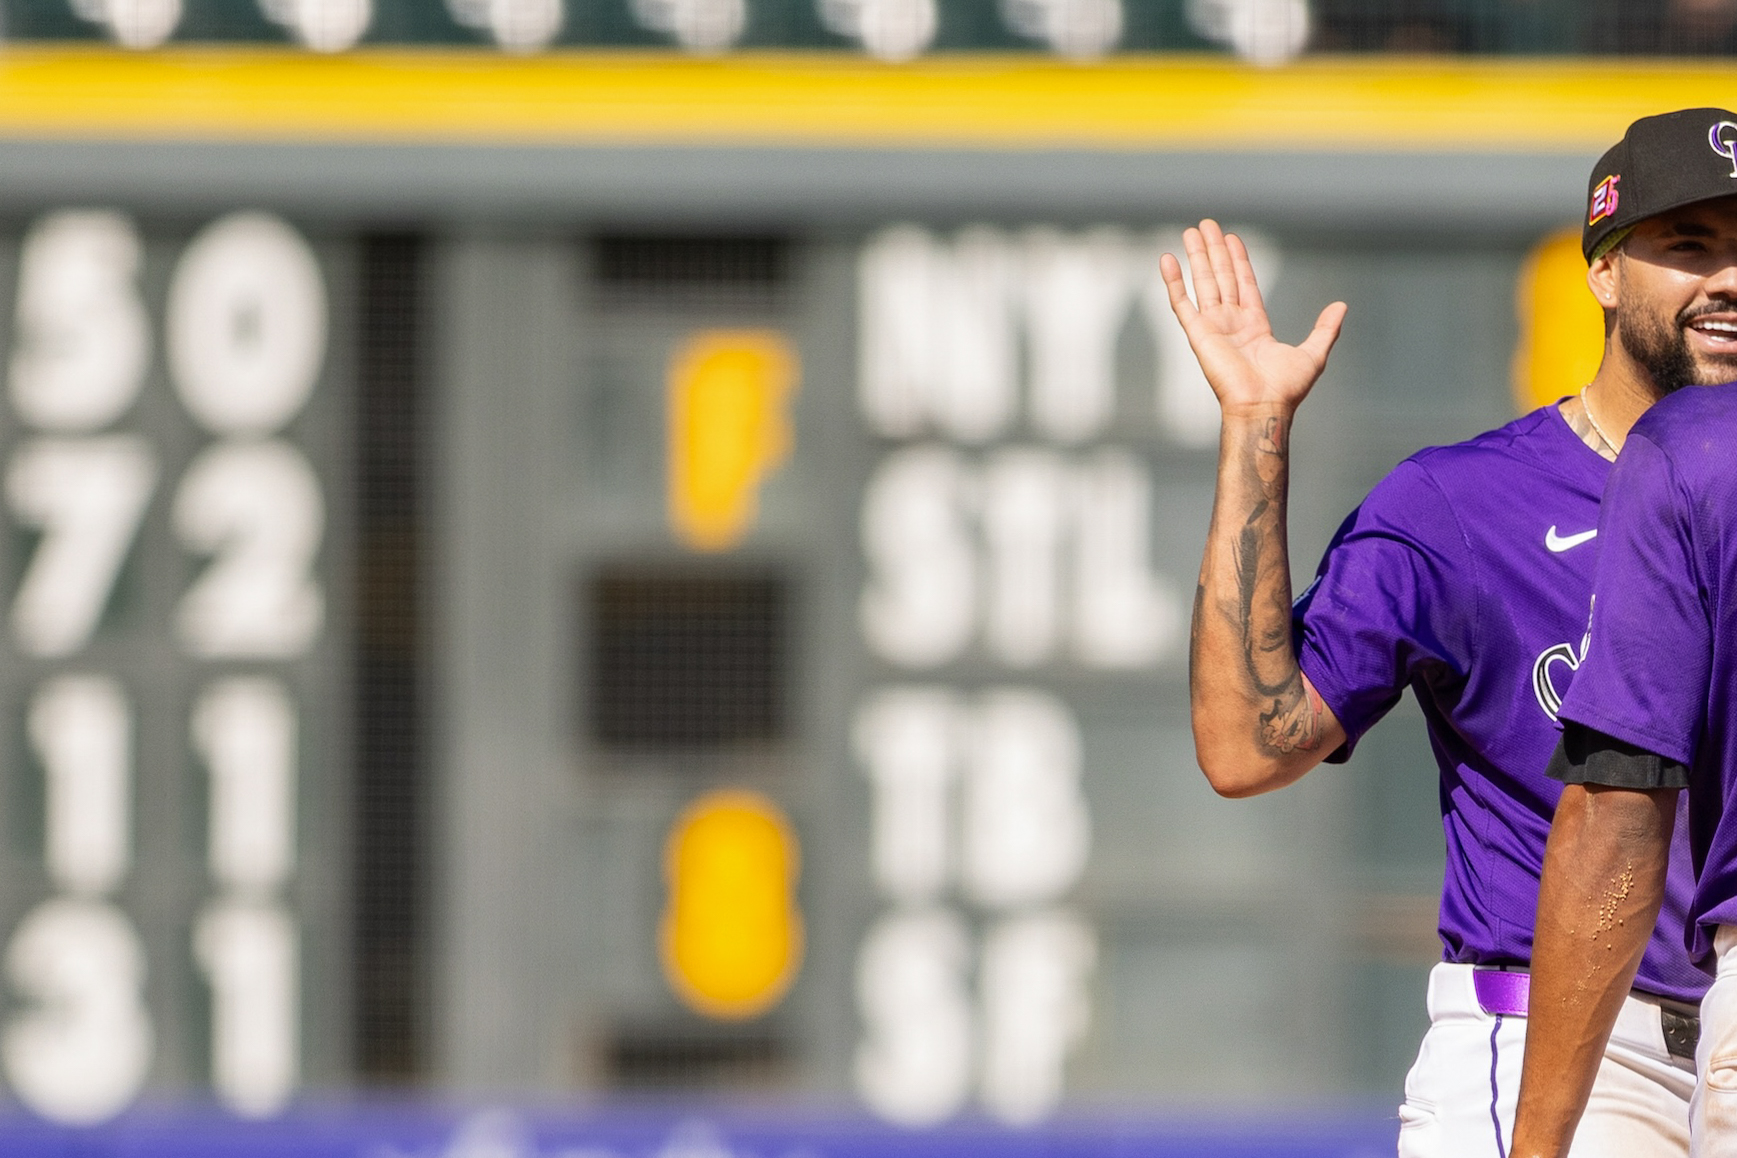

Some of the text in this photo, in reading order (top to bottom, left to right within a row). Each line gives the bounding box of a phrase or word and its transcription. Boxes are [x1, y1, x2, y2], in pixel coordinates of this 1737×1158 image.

[165, 210, 328, 436] 0
[8, 434, 326, 660] 7 2
[858, 443, 1188, 670] STL
[27, 672, 297, 892] 1 1
[850, 685, 1092, 908] TB
[4, 893, 299, 1127] 3 1
[855, 905, 1100, 1127] SF
